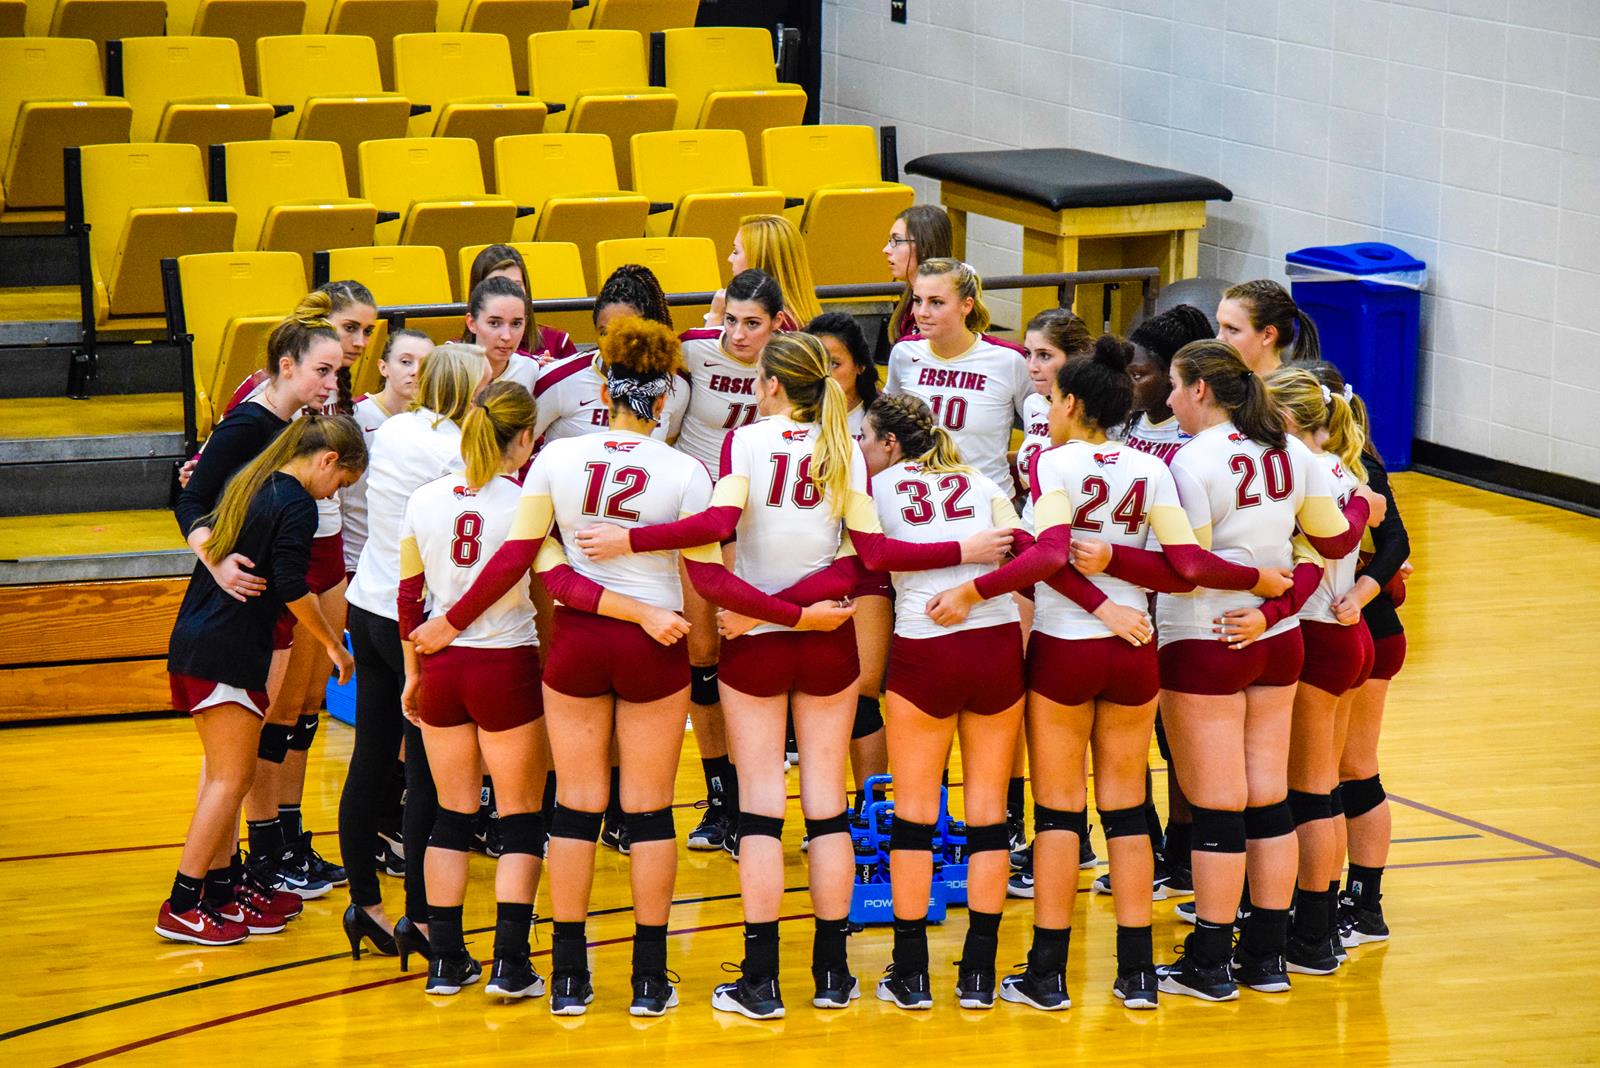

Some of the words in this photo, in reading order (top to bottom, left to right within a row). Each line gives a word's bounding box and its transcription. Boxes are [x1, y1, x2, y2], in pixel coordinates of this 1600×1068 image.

[709, 374, 756, 396] ERSK
[918, 368, 987, 391] ERSKINE
[722, 402, 758, 429] 11
[930, 395, 968, 431] 10
[581, 461, 651, 522] 12
[766, 452, 824, 509] 18
[895, 474, 976, 526] 32
[1071, 475, 1148, 535] 24
[1228, 448, 1295, 509] 20
[450, 510, 485, 568] 8
